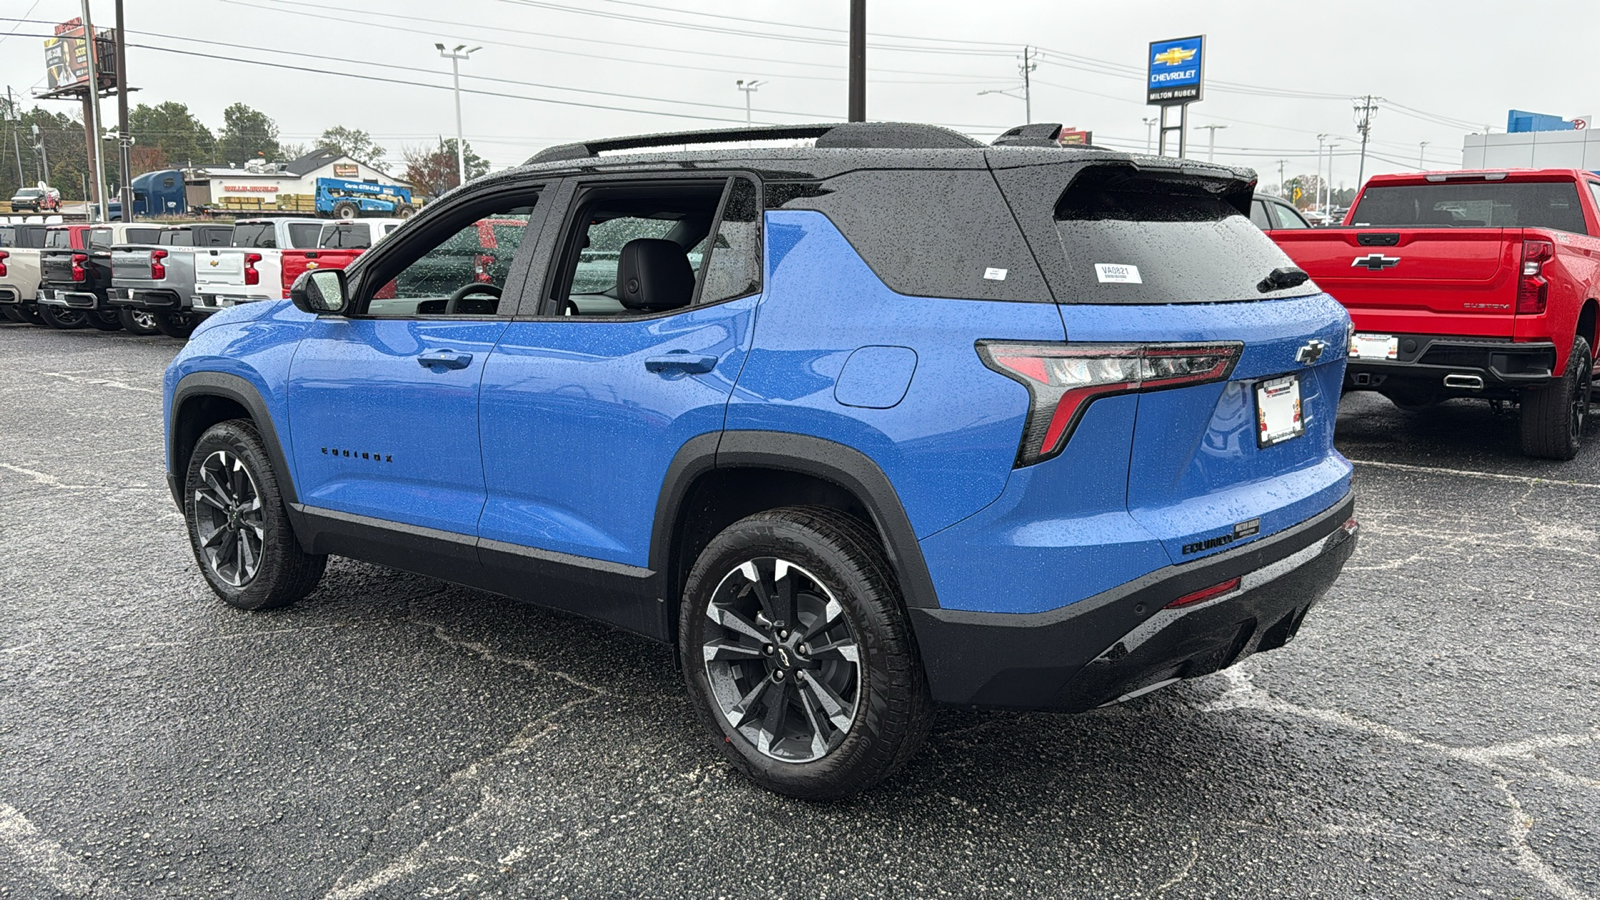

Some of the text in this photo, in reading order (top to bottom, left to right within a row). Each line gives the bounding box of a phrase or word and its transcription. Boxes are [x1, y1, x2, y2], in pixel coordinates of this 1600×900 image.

[1151, 70, 1196, 82] CHEVROLET
[1150, 89, 1196, 100] MILTON RUBEN
[1101, 266, 1129, 275] VA0821
[321, 447, 393, 463] EQUINOX
[1182, 534, 1233, 554] EQUINOX
